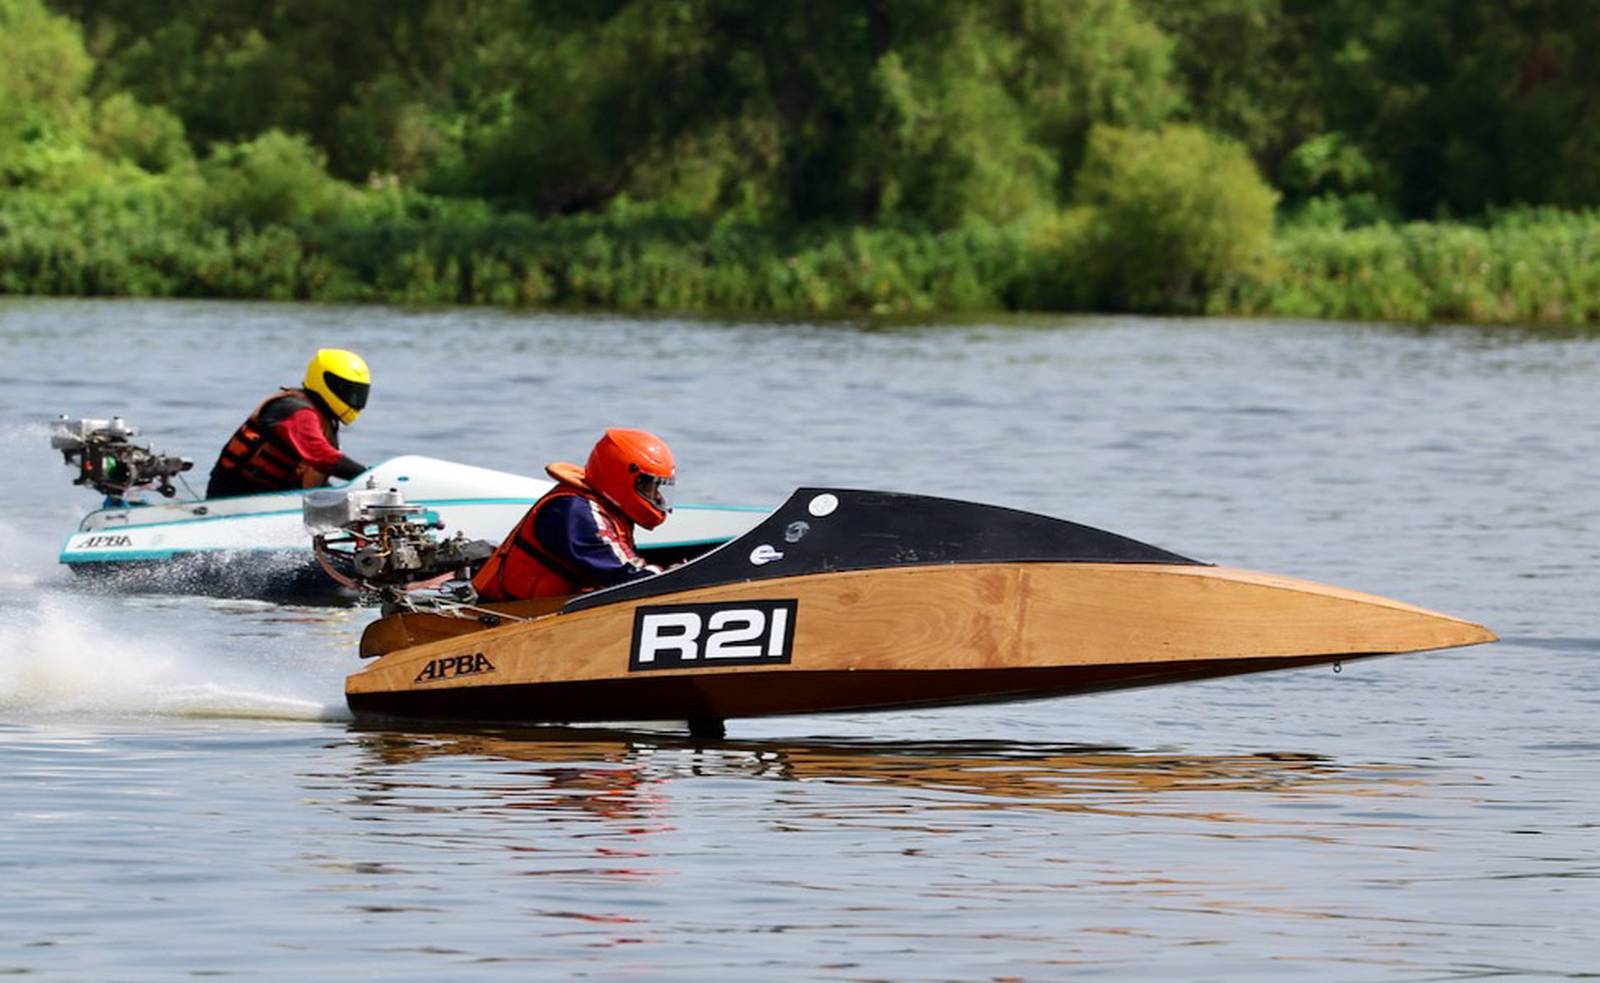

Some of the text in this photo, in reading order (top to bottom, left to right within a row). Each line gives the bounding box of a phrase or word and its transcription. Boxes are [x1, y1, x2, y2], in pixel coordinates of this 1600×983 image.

[76, 535, 133, 549] APBA
[638, 608, 789, 663] R21
[413, 652, 496, 683] APBA
